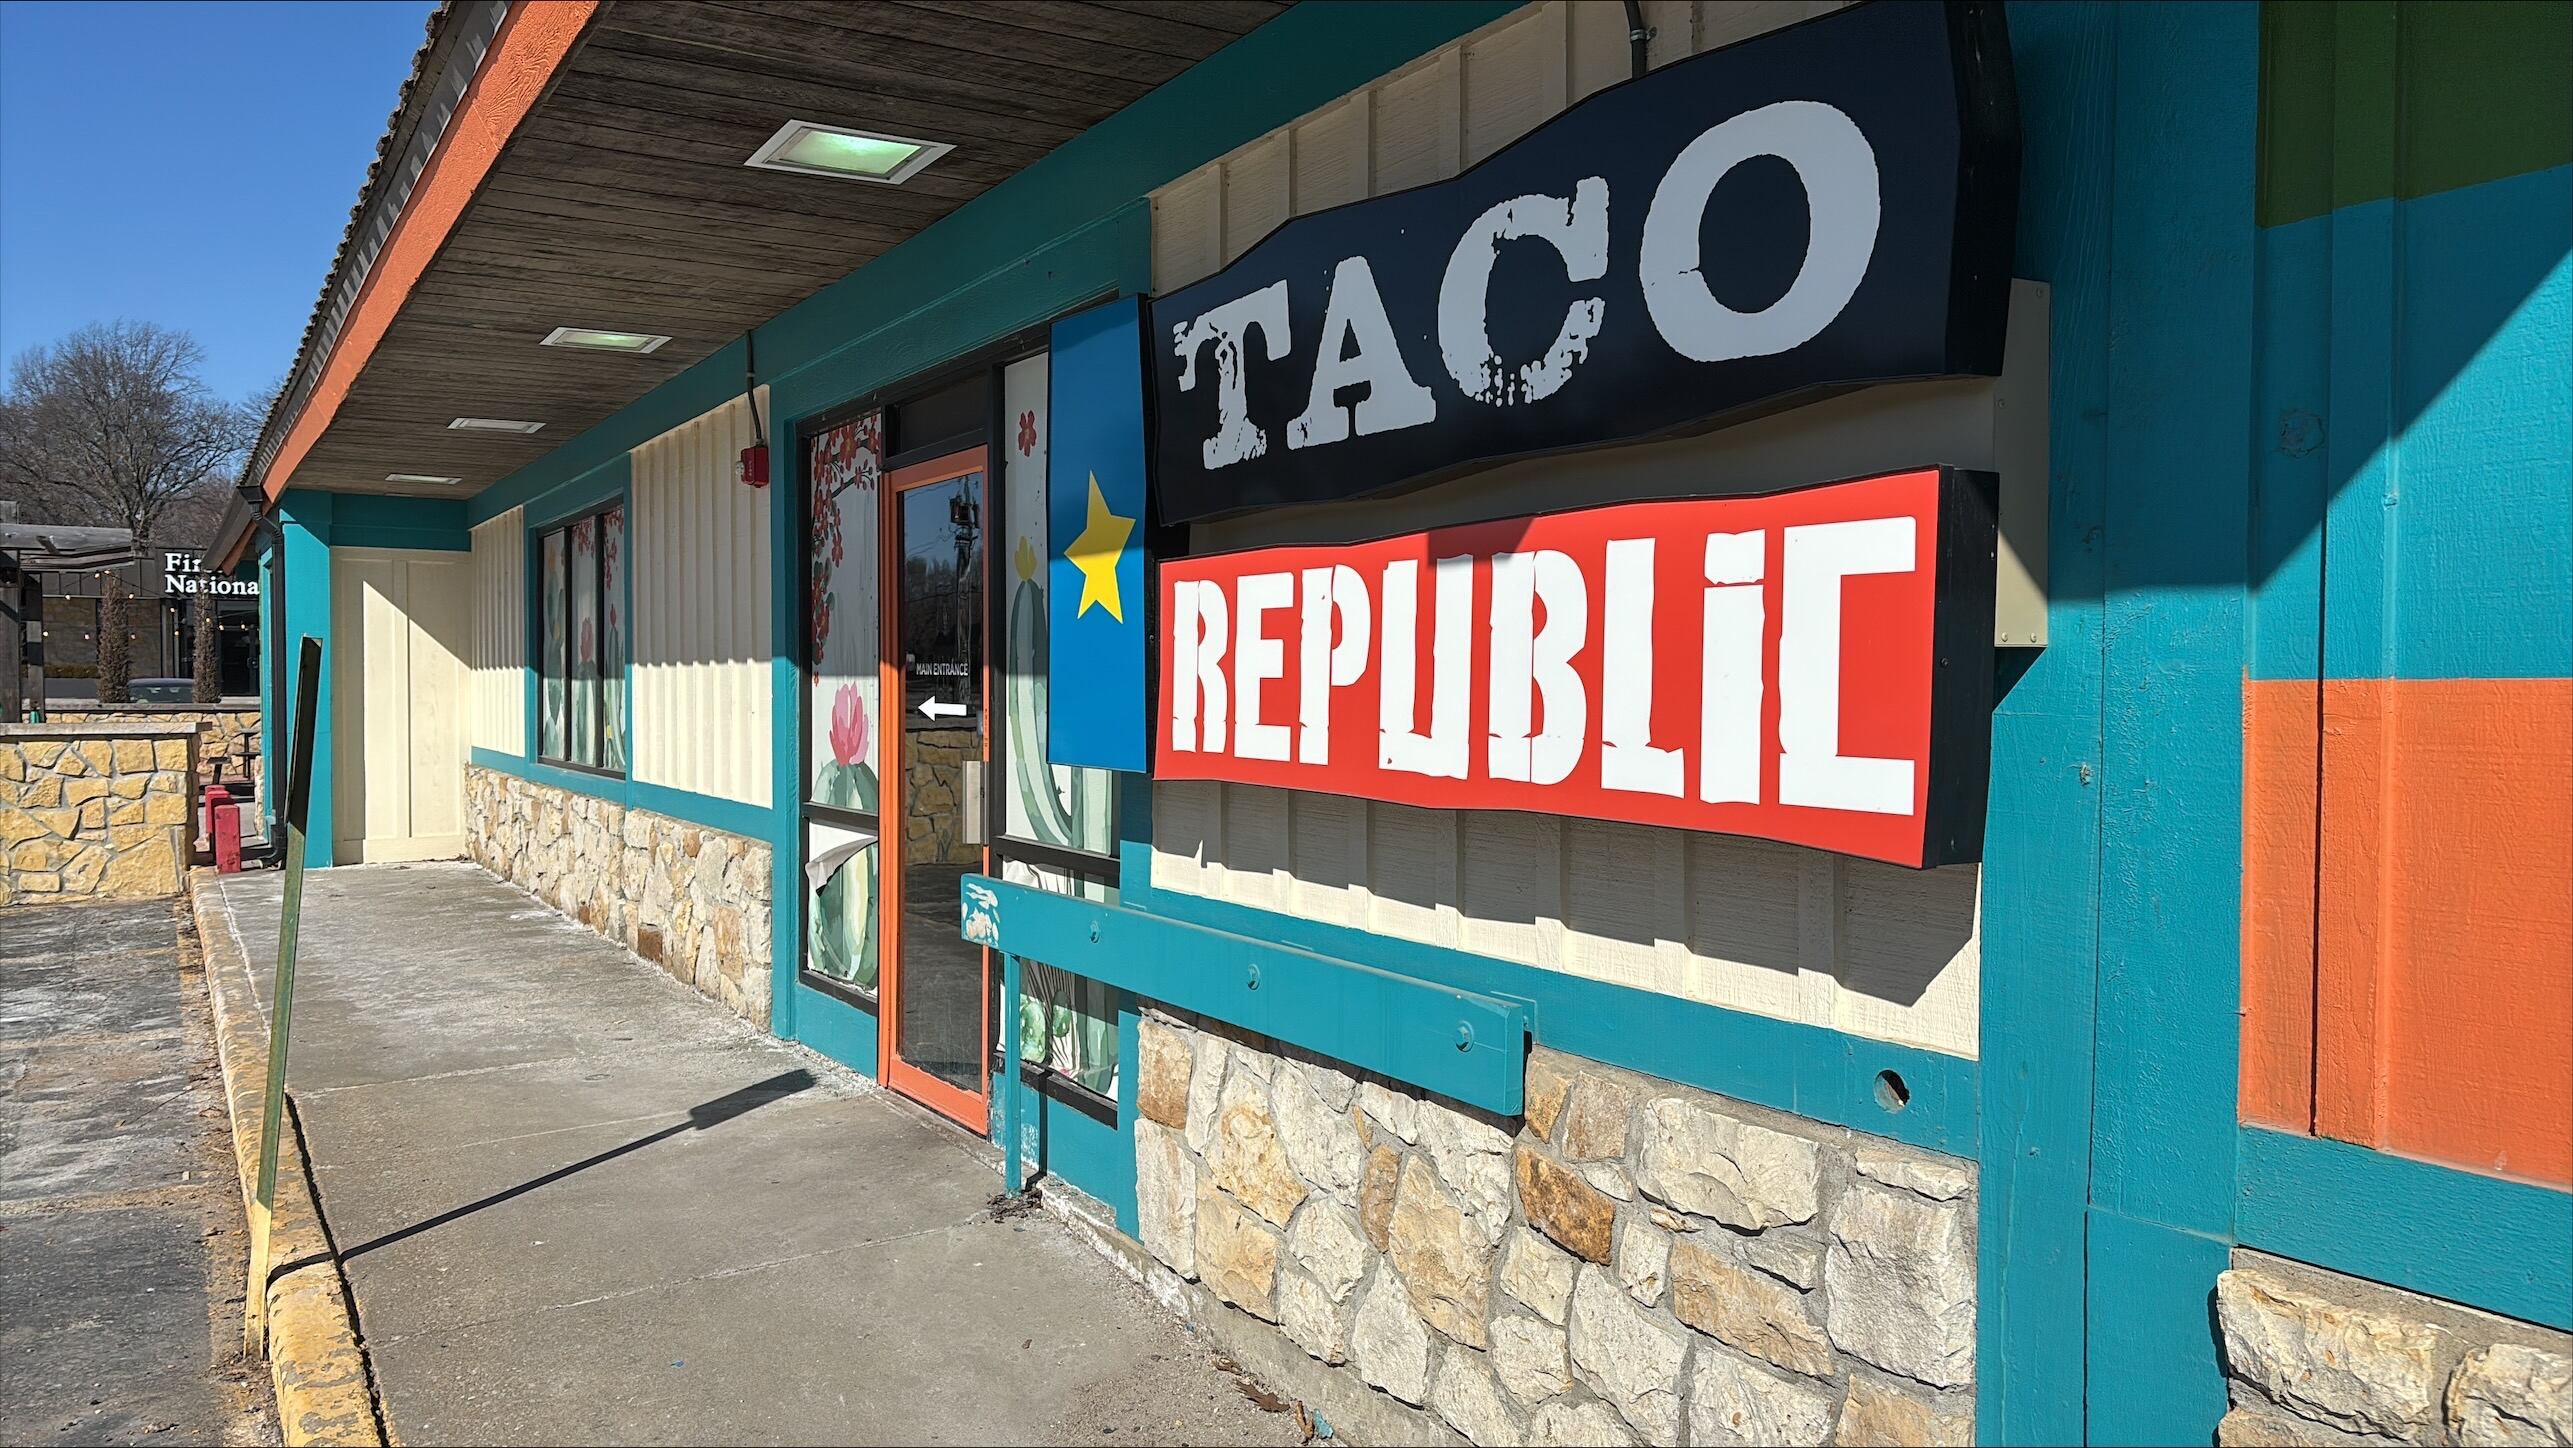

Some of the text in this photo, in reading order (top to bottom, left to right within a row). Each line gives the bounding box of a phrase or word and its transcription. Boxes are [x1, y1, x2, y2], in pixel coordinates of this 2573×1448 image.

[1172, 100, 1882, 470] TACO
[164, 552, 223, 573] Fir
[164, 574, 260, 595] Nationa
[916, 662, 968, 676] MAIN ENTRANCE
